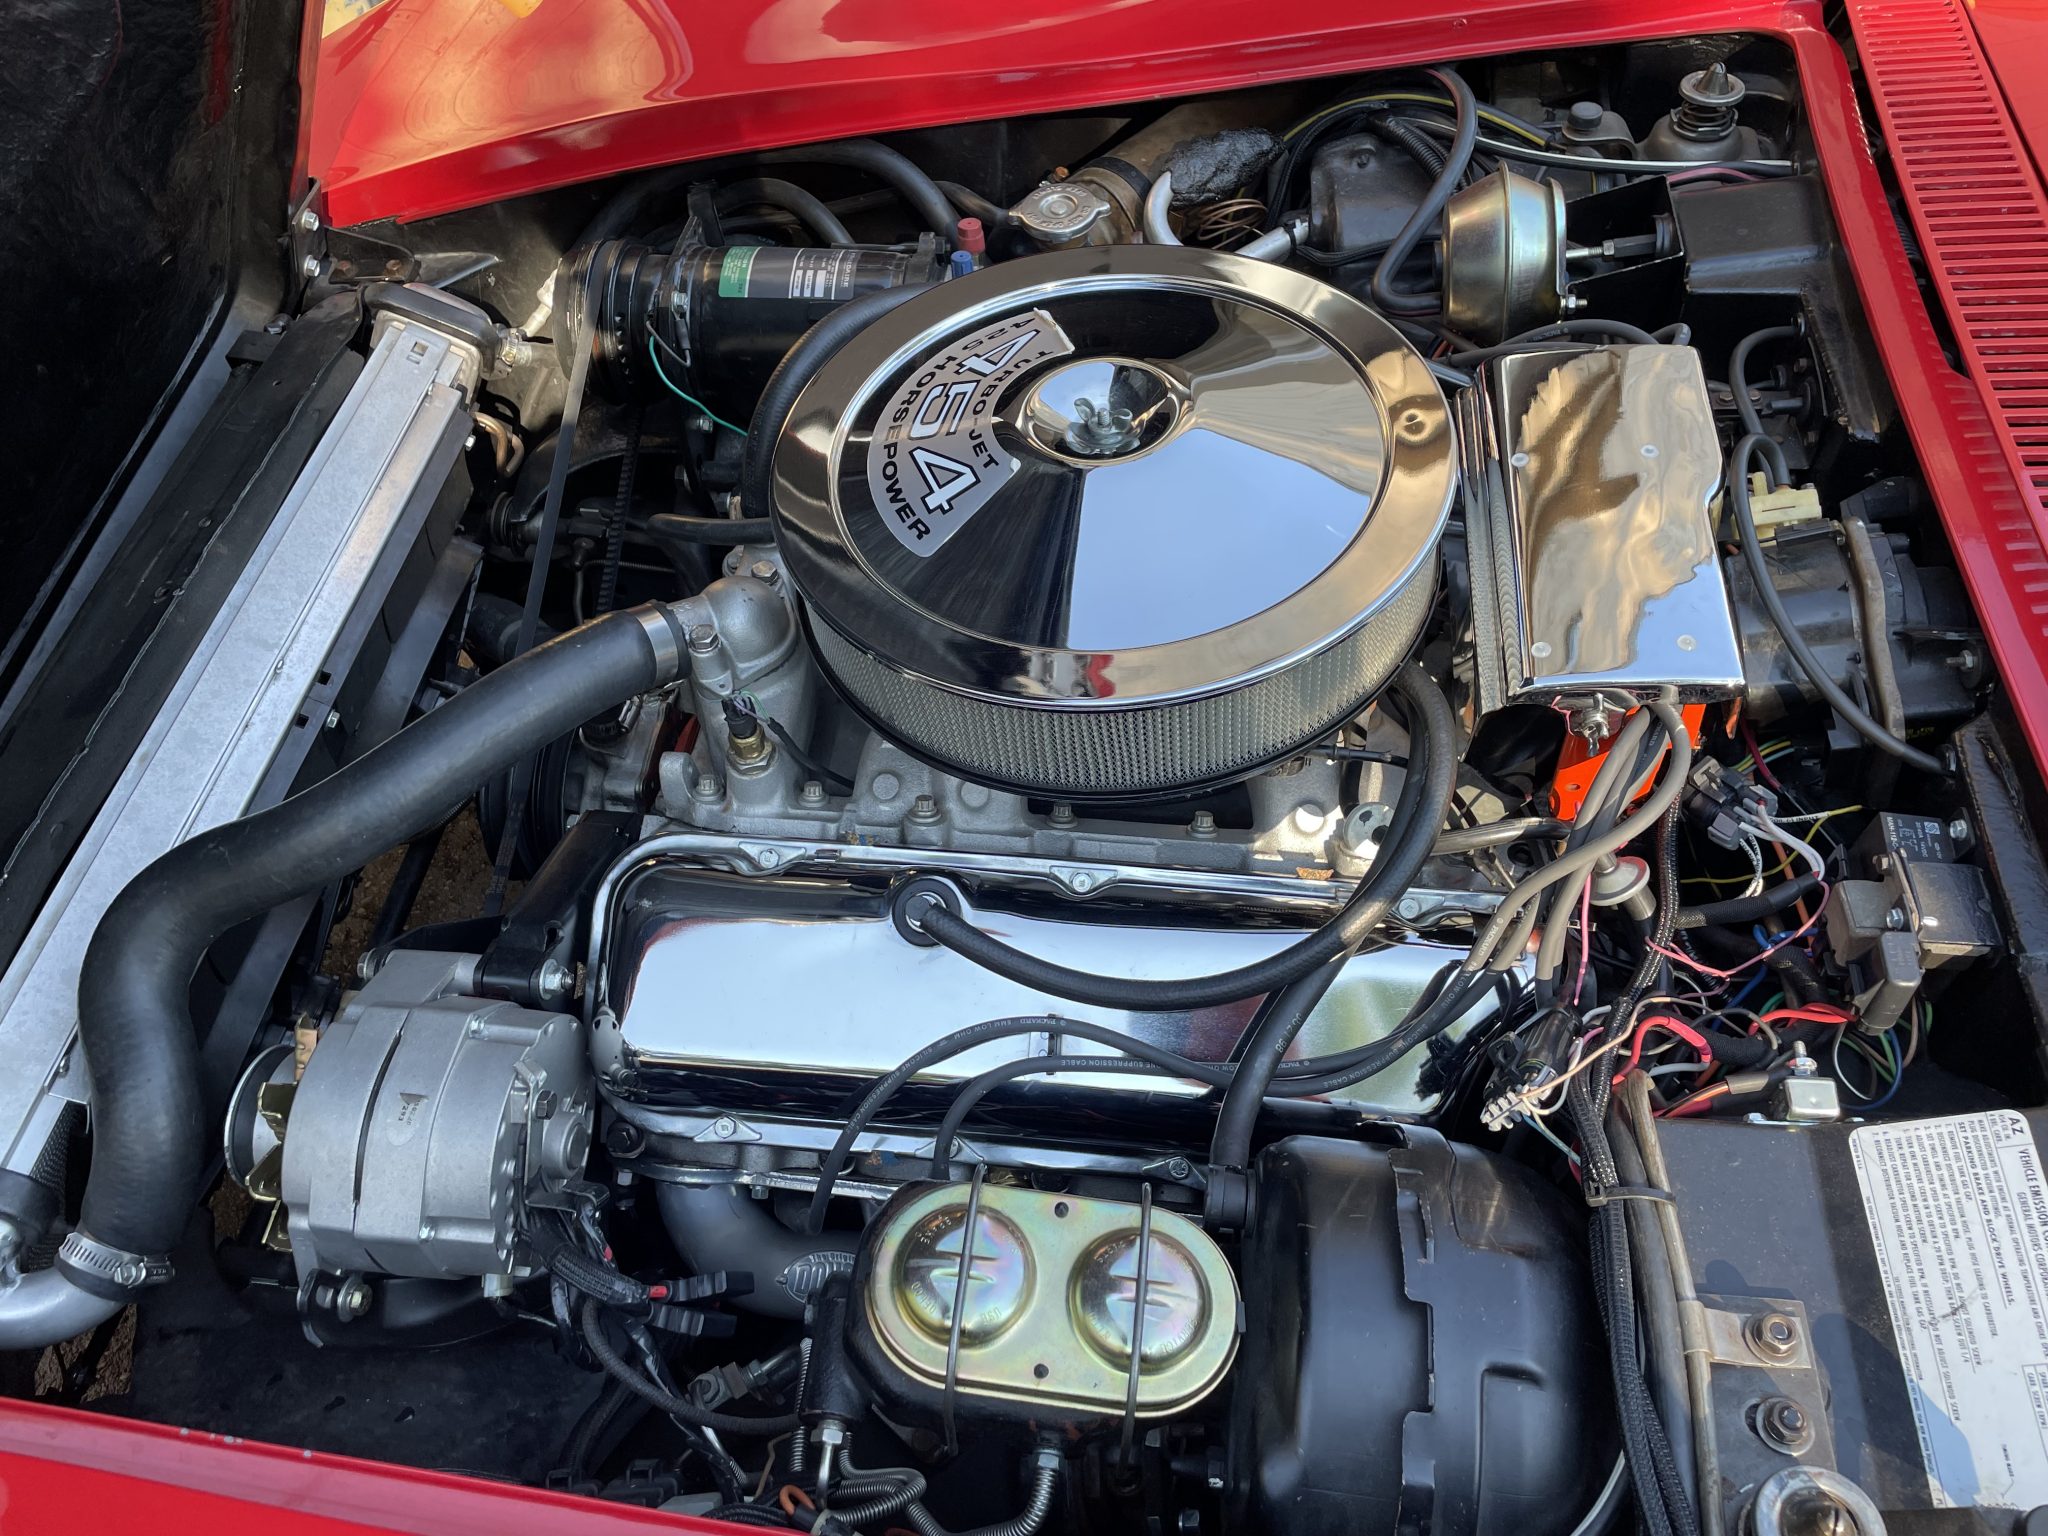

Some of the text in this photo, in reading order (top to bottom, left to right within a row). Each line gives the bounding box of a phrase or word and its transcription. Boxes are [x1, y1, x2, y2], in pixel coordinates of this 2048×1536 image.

[969, 350, 1054, 469] TURBO-JET
[882, 318, 1036, 540] 425 HORSEPOWER
[909, 329, 1040, 515] 454
[974, 1024, 993, 1033] LOW
[1020, 1018, 1057, 1026] PACKARD
[953, 1028, 973, 1041] OHM
[900, 1048, 933, 1072] SILICONE
[1060, 1058, 1087, 1066] CABLE
[1088, 1059, 1144, 1068] SUPPRESSION
[859, 1070, 901, 1115] SUPPRESSION
[1957, 1121, 1967, 1133] SET
[2008, 1116, 2024, 1135] AZ
[1961, 1135, 1977, 1169] PARKING
[1971, 1172, 1984, 1195] BRAKE
[2017, 1148, 2048, 1226] VEHICLE EMISSION
[1979, 1198, 1990, 1215] AND
[1985, 1218, 1998, 1243] BLOCK
[2016, 1191, 2042, 1251] GENERAL MOTORS
[1993, 1246, 2005, 1268] DRIVE
